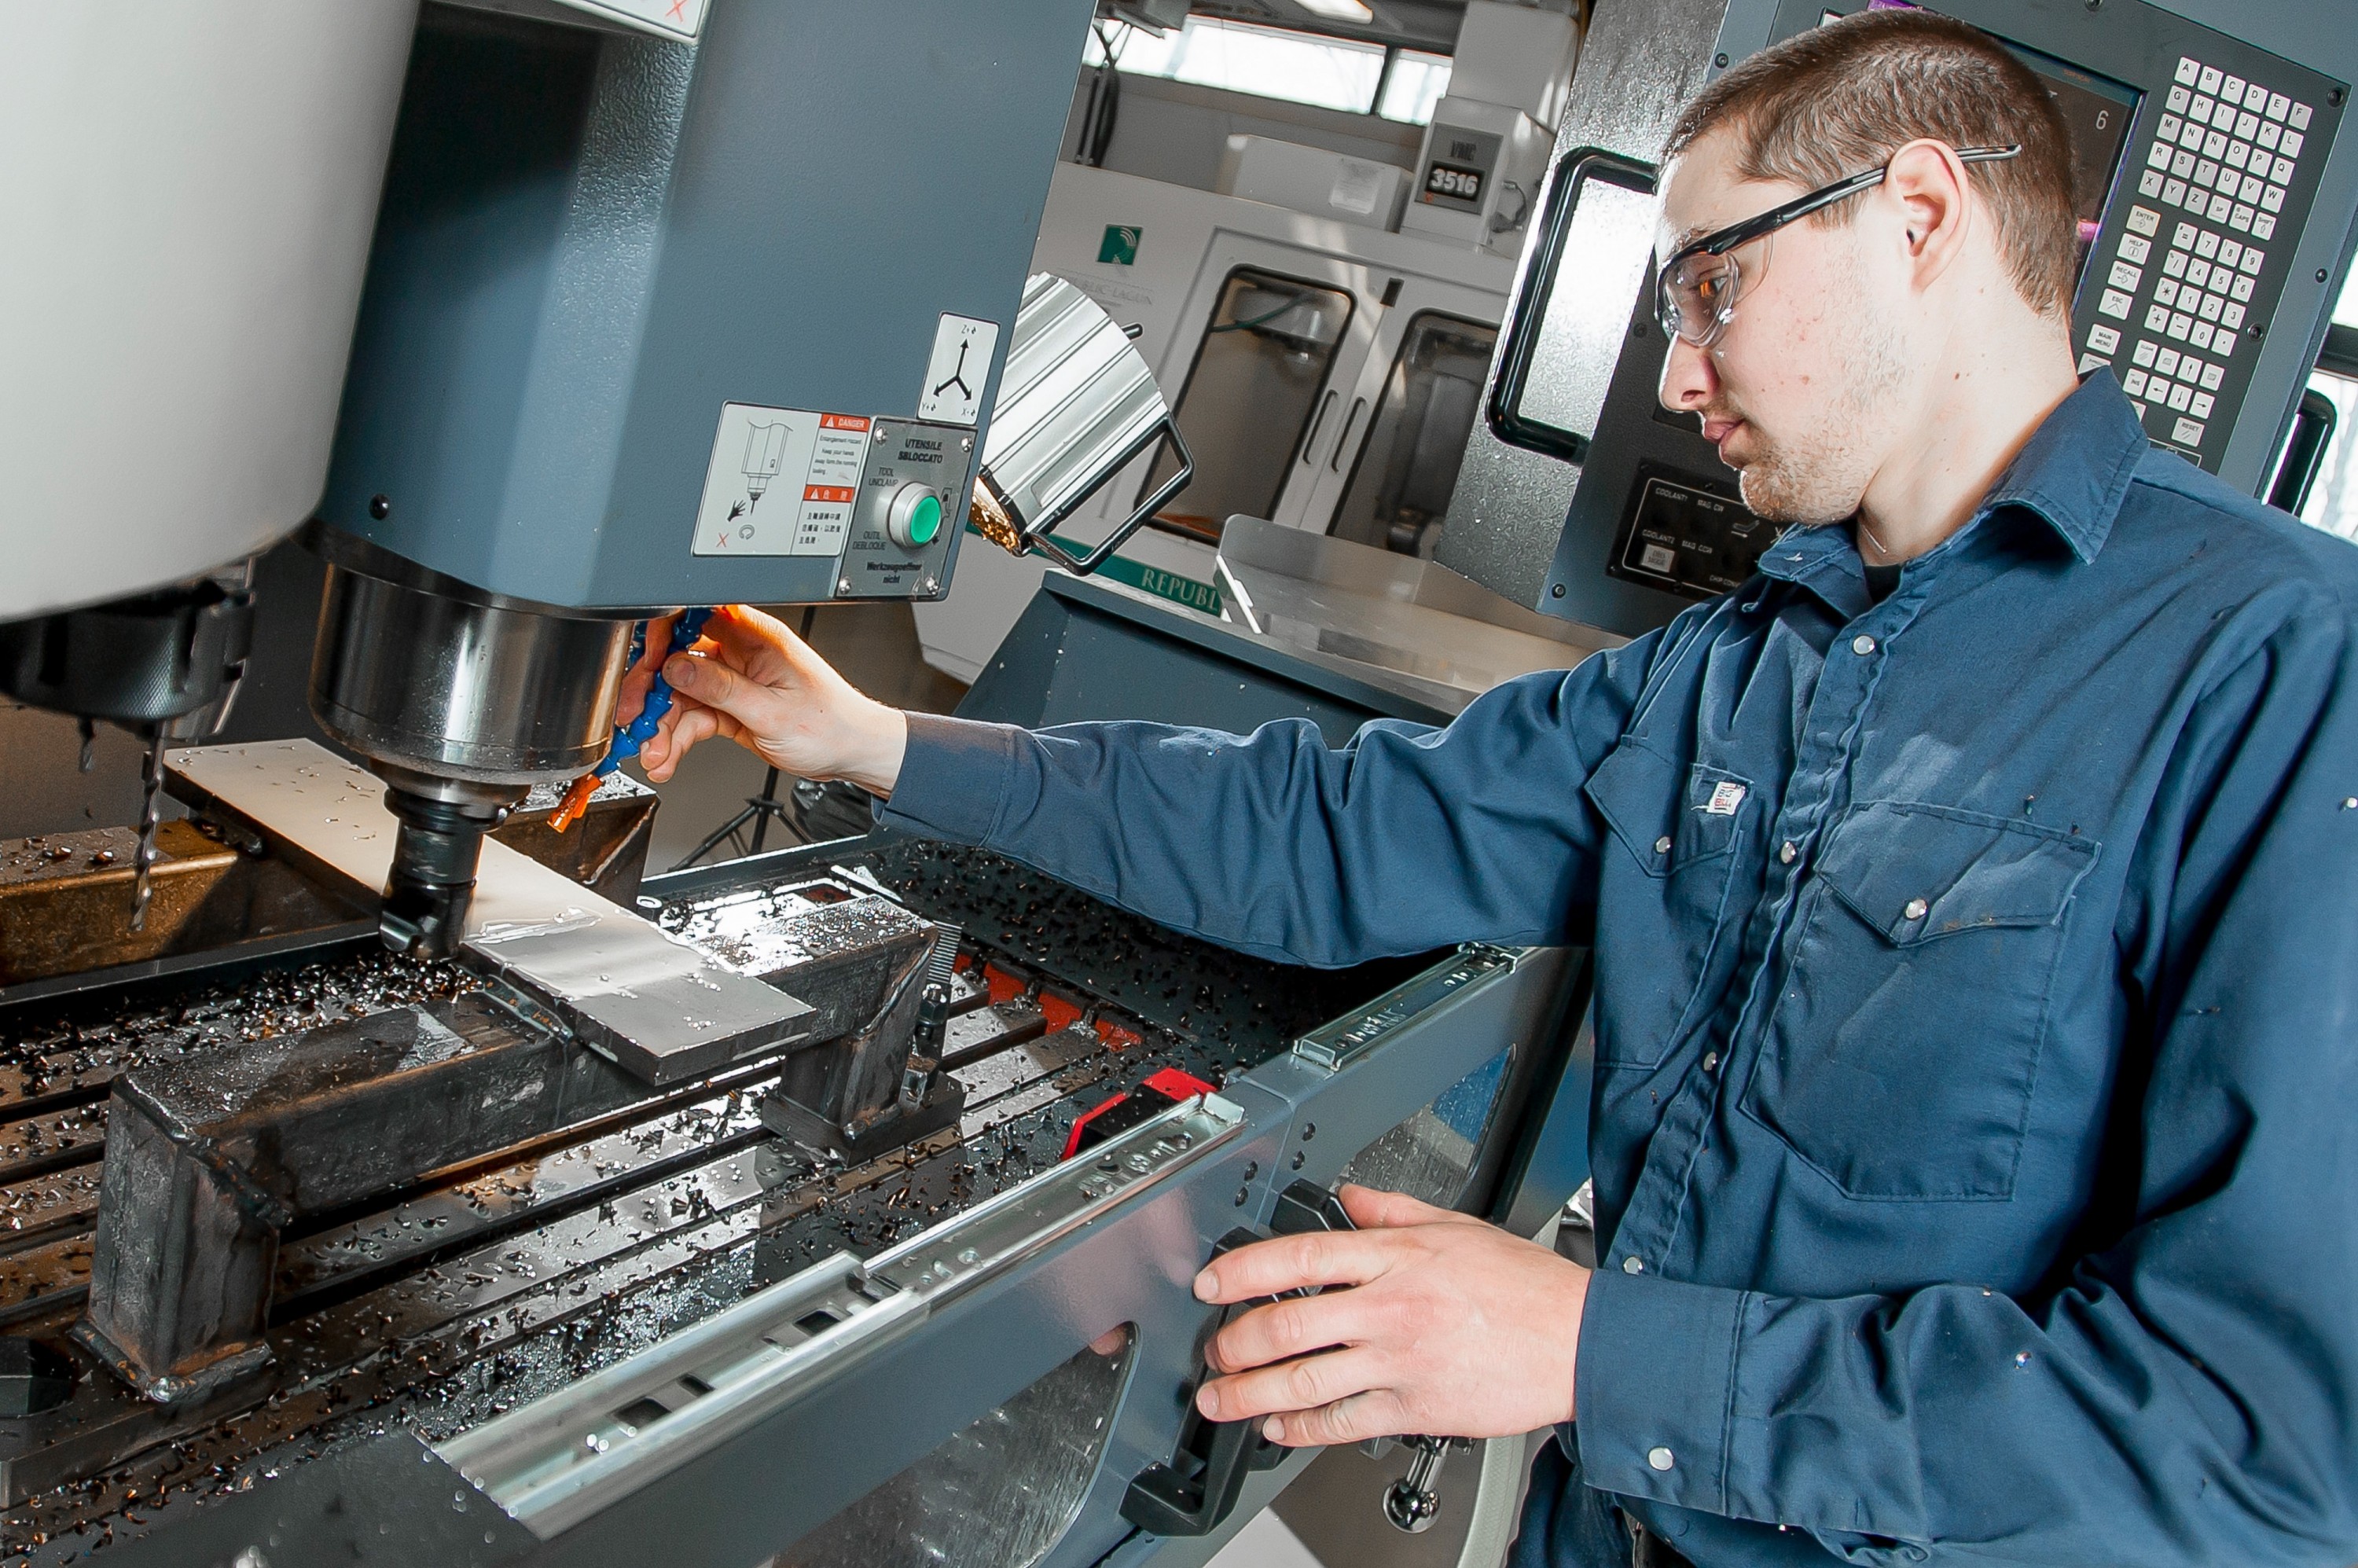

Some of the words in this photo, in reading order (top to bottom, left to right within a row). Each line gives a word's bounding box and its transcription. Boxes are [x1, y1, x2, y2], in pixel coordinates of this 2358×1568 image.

[2183, 63, 2189, 72] A
[2206, 72, 2212, 80] B
[2274, 99, 2280, 108] E
[2095, 110, 2109, 130] 6
[2165, 119, 2173, 128] M
[2188, 128, 2195, 137] N
[2264, 127, 2272, 135] K
[2287, 135, 2292, 144] L
[1431, 168, 1478, 193] 3516
[2268, 190, 2277, 199] W
[2136, 211, 2154, 221] ENTER
[2235, 213, 2250, 222] CAPS
[2116, 266, 2136, 277] RECALL
[2182, 422, 2200, 431] RESET
[905, 439, 942, 450] UTENSILE
[898, 450, 942, 463] SBLOCCATO
[880, 467, 894, 476] TOOL
[869, 478, 898, 487] UNCLAMP
[864, 531, 880, 539] OUTIL
